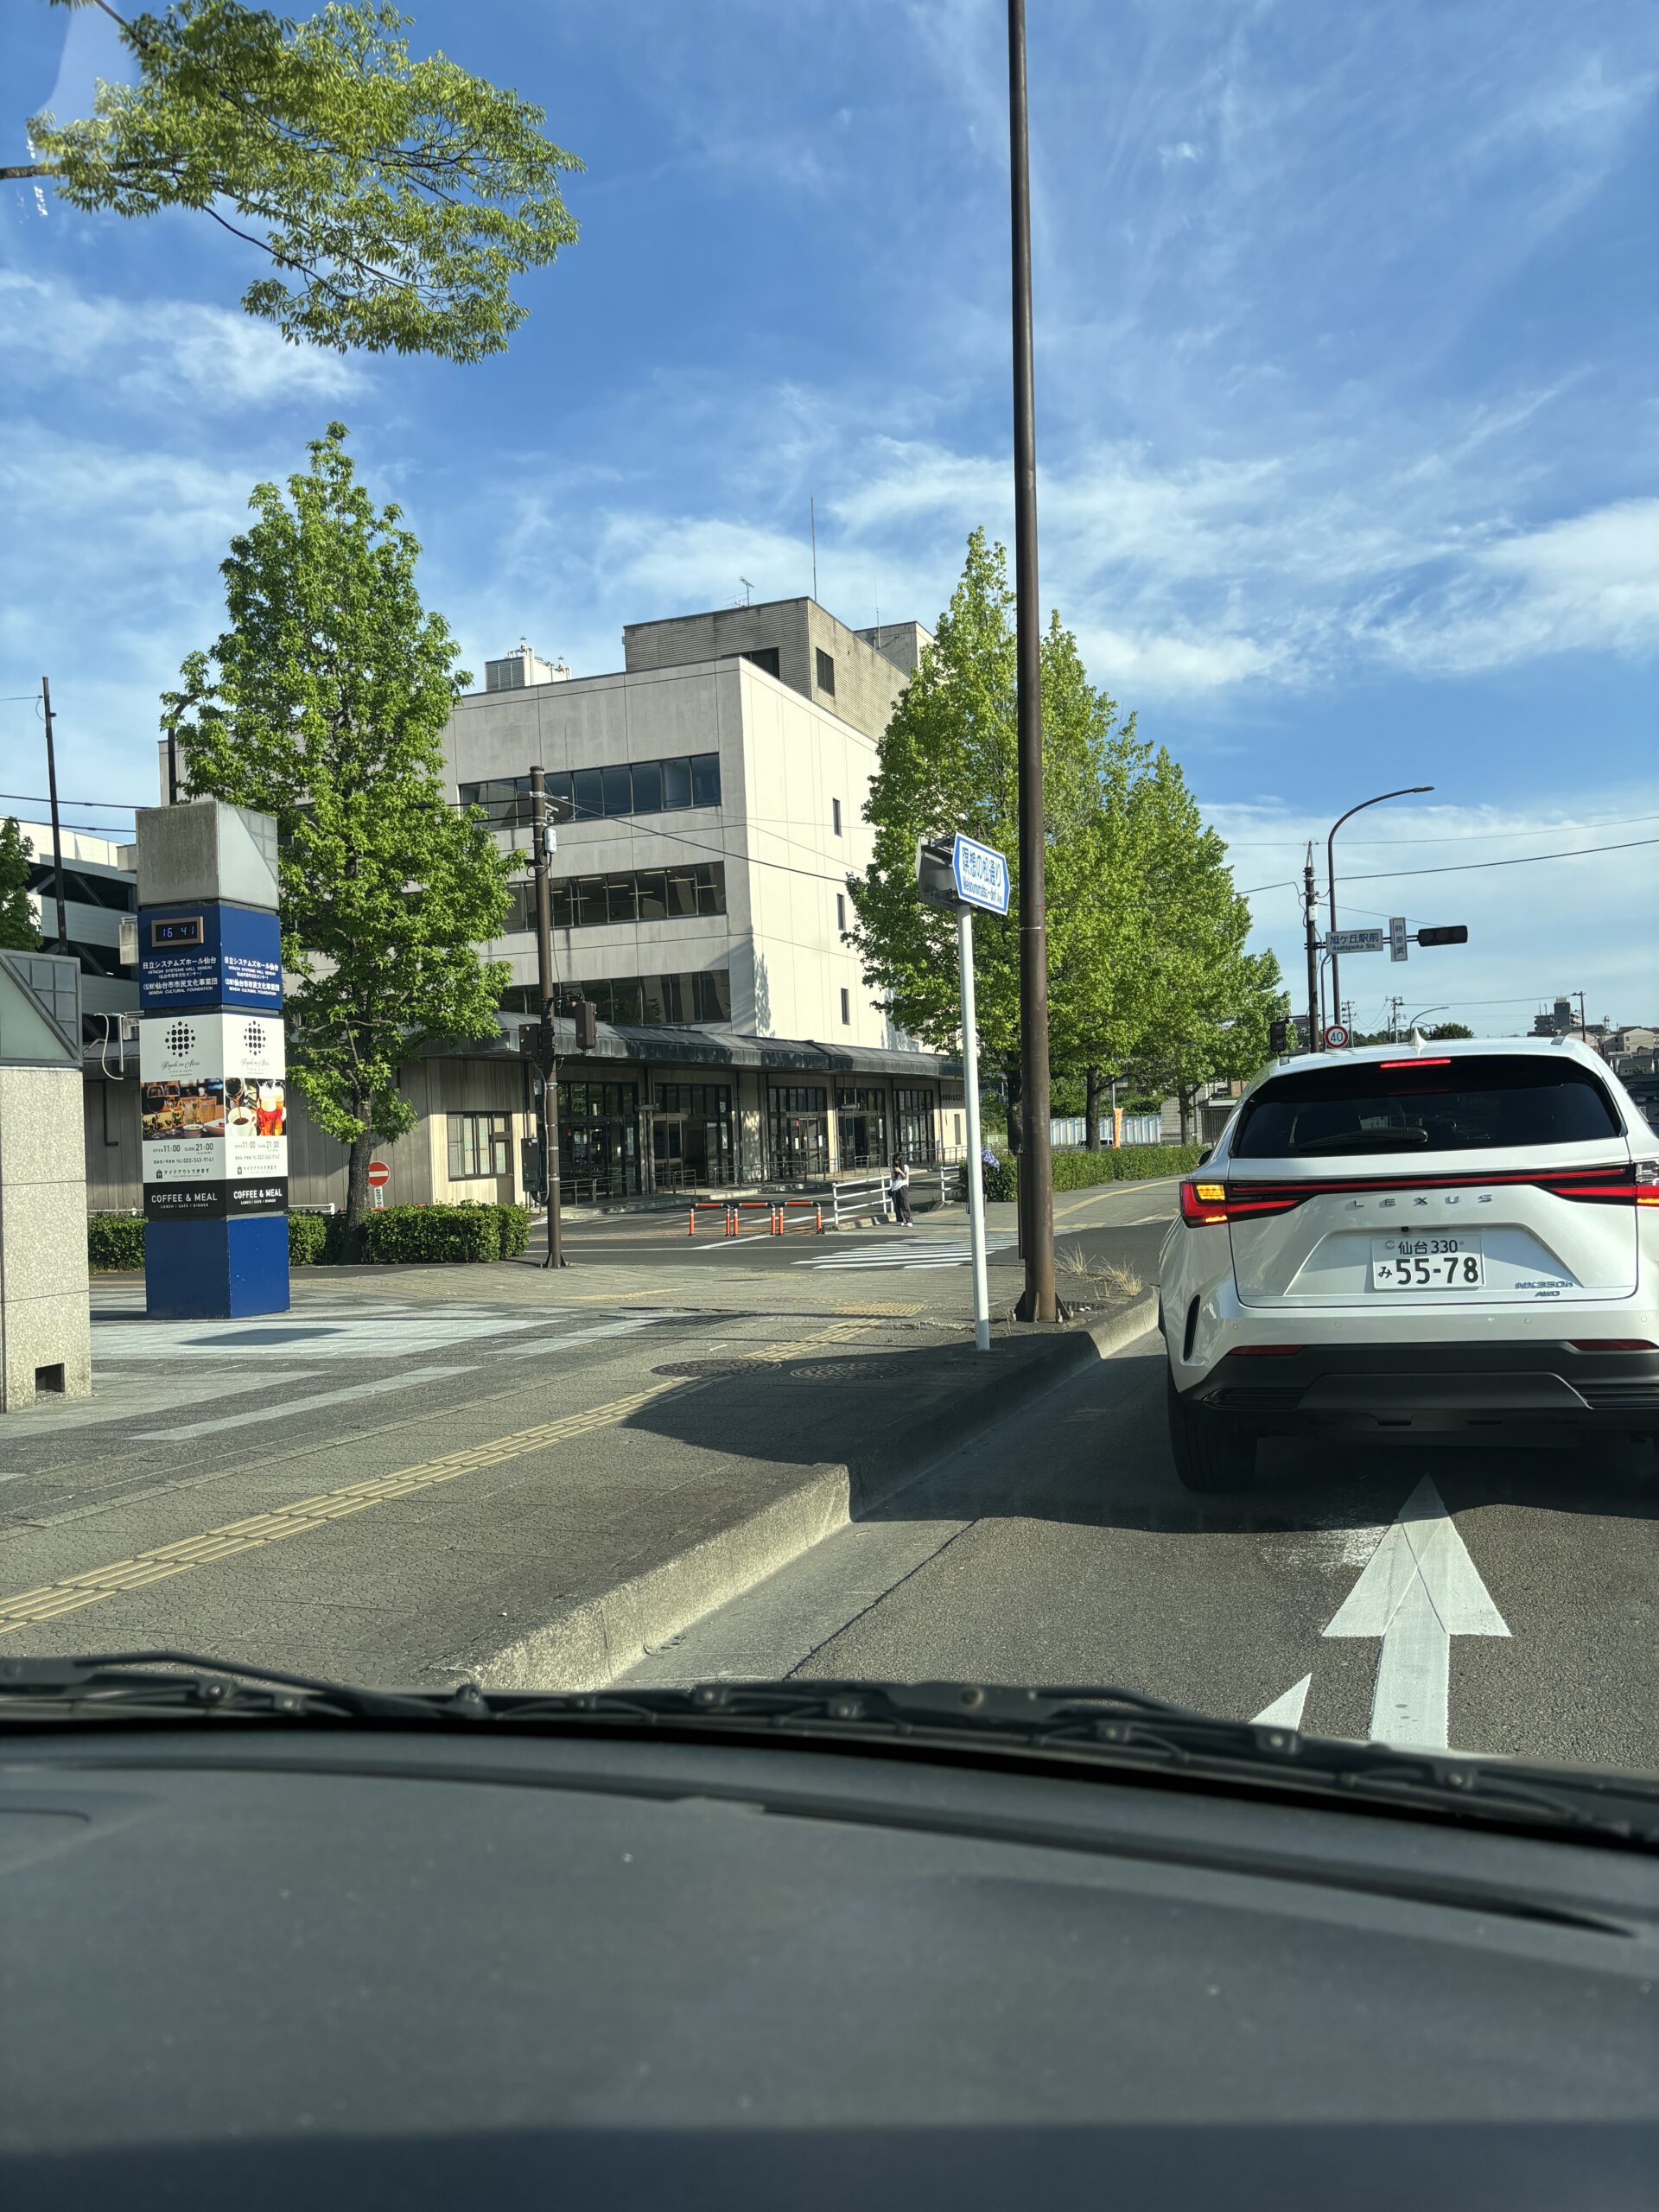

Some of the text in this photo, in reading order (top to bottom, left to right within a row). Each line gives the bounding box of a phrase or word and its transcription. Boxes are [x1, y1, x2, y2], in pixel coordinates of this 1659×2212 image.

[163, 925, 194, 938] 16 41
[1395, 925, 1405, 955] 時差式
[143, 956, 217, 969] 日立システムズホール仙台
[1330, 1031, 1344, 1042] 40
[163, 1144, 181, 1153] 11:00
[195, 1142, 214, 1152] 21:00
[151, 1192, 218, 1204] COFFEE & MEAL
[233, 1188, 283, 1199] COFFEE & MEAL
[1354, 1194, 1493, 1208] LEXUS
[1397, 1239, 1458, 1255] 仙台 330
[1377, 1256, 1478, 1285] み 55-78
